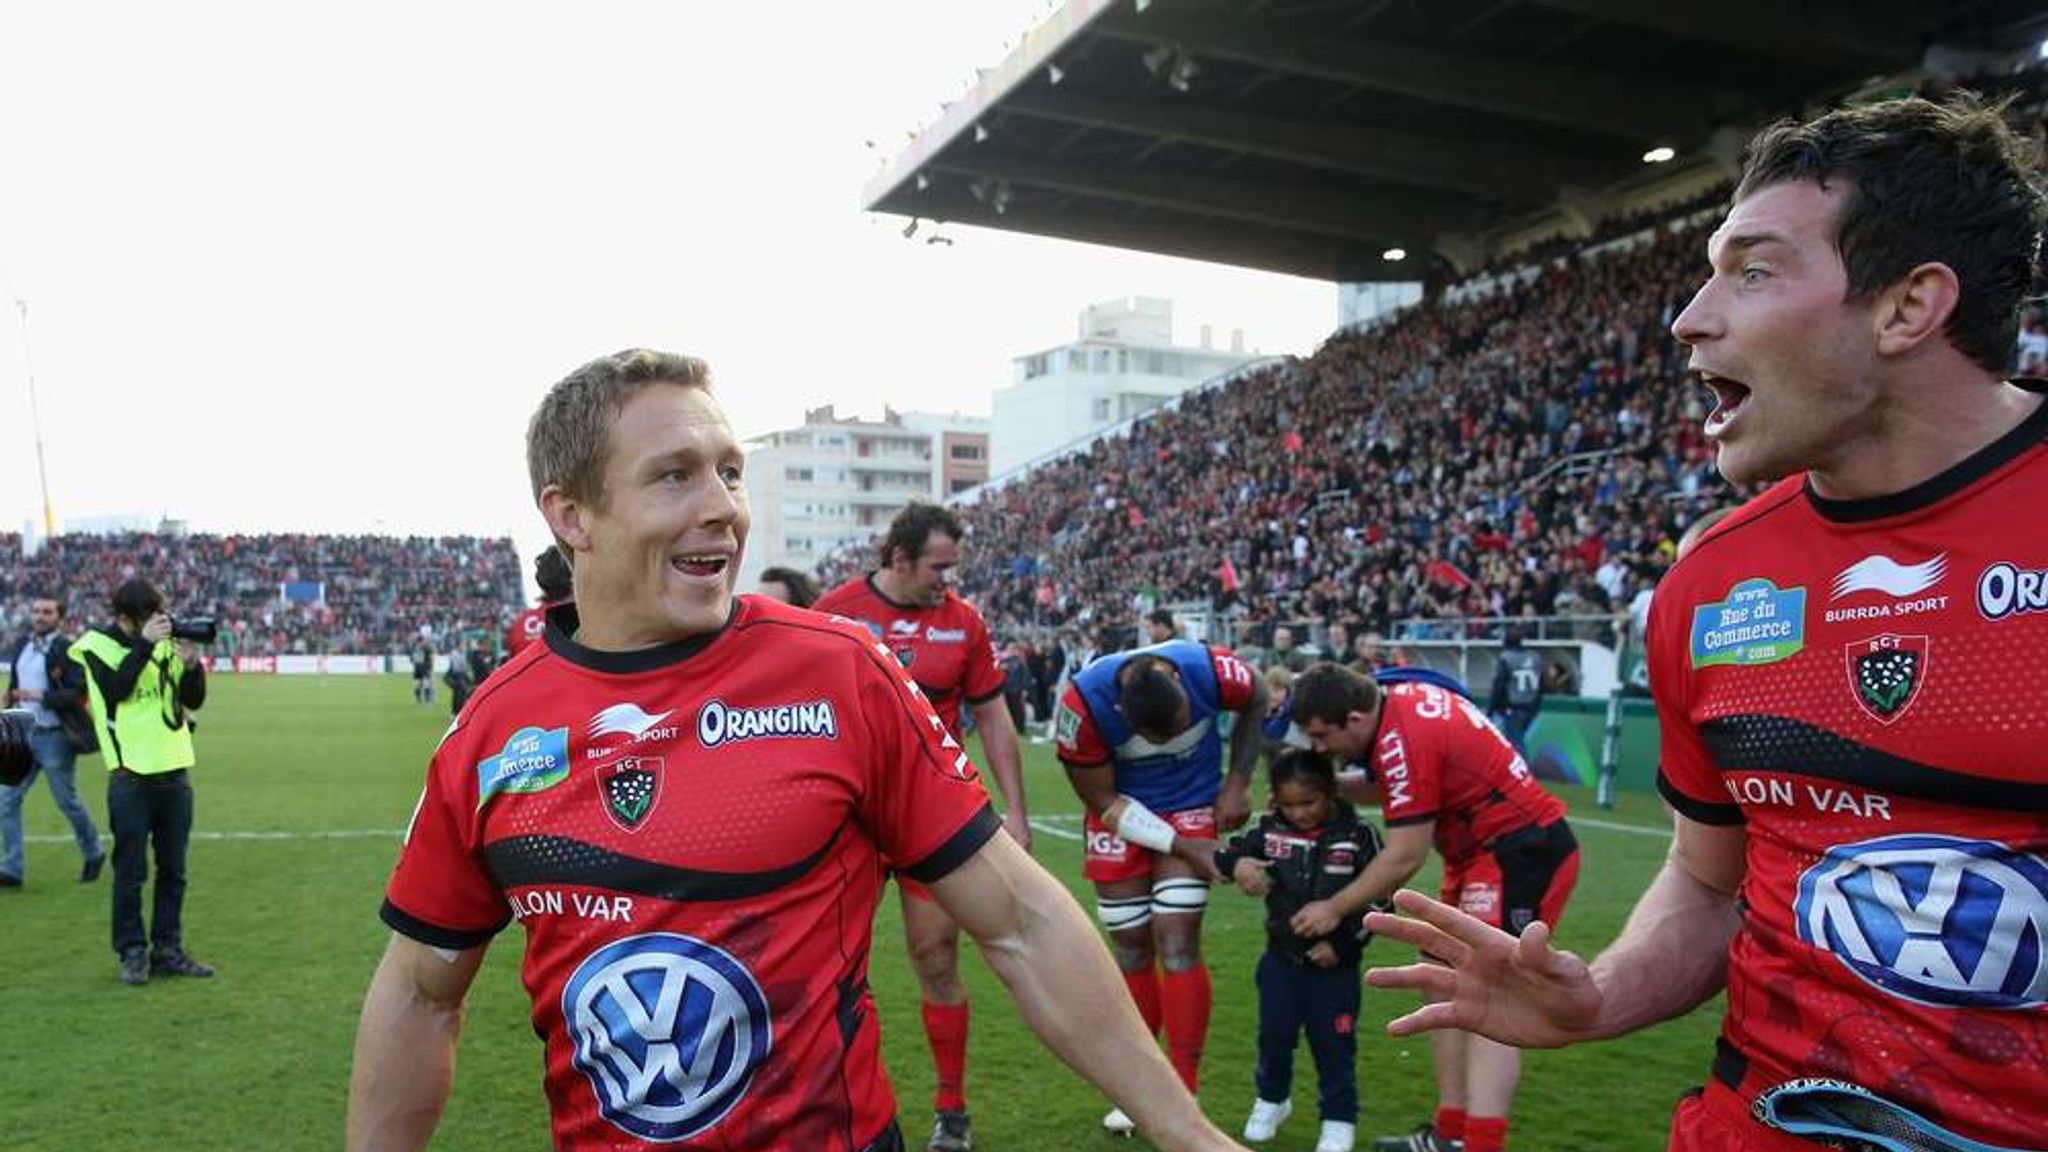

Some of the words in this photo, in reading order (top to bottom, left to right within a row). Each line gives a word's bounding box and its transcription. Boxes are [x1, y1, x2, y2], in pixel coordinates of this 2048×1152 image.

[1720, 607, 1749, 627] Rue
[1752, 600, 1776, 619] du
[1825, 604, 1891, 622] BURRDA
[1894, 596, 1949, 616] SPORT
[1703, 620, 1792, 649] Commerce
[1869, 636, 1901, 652] RCT
[1513, 669, 1541, 691] TV
[633, 726, 679, 744] SPORT
[698, 700, 837, 747] ORANGINA
[616, 758, 643, 774] RCT
[1806, 785, 1892, 821] VAR
[572, 892, 634, 923] VAR
